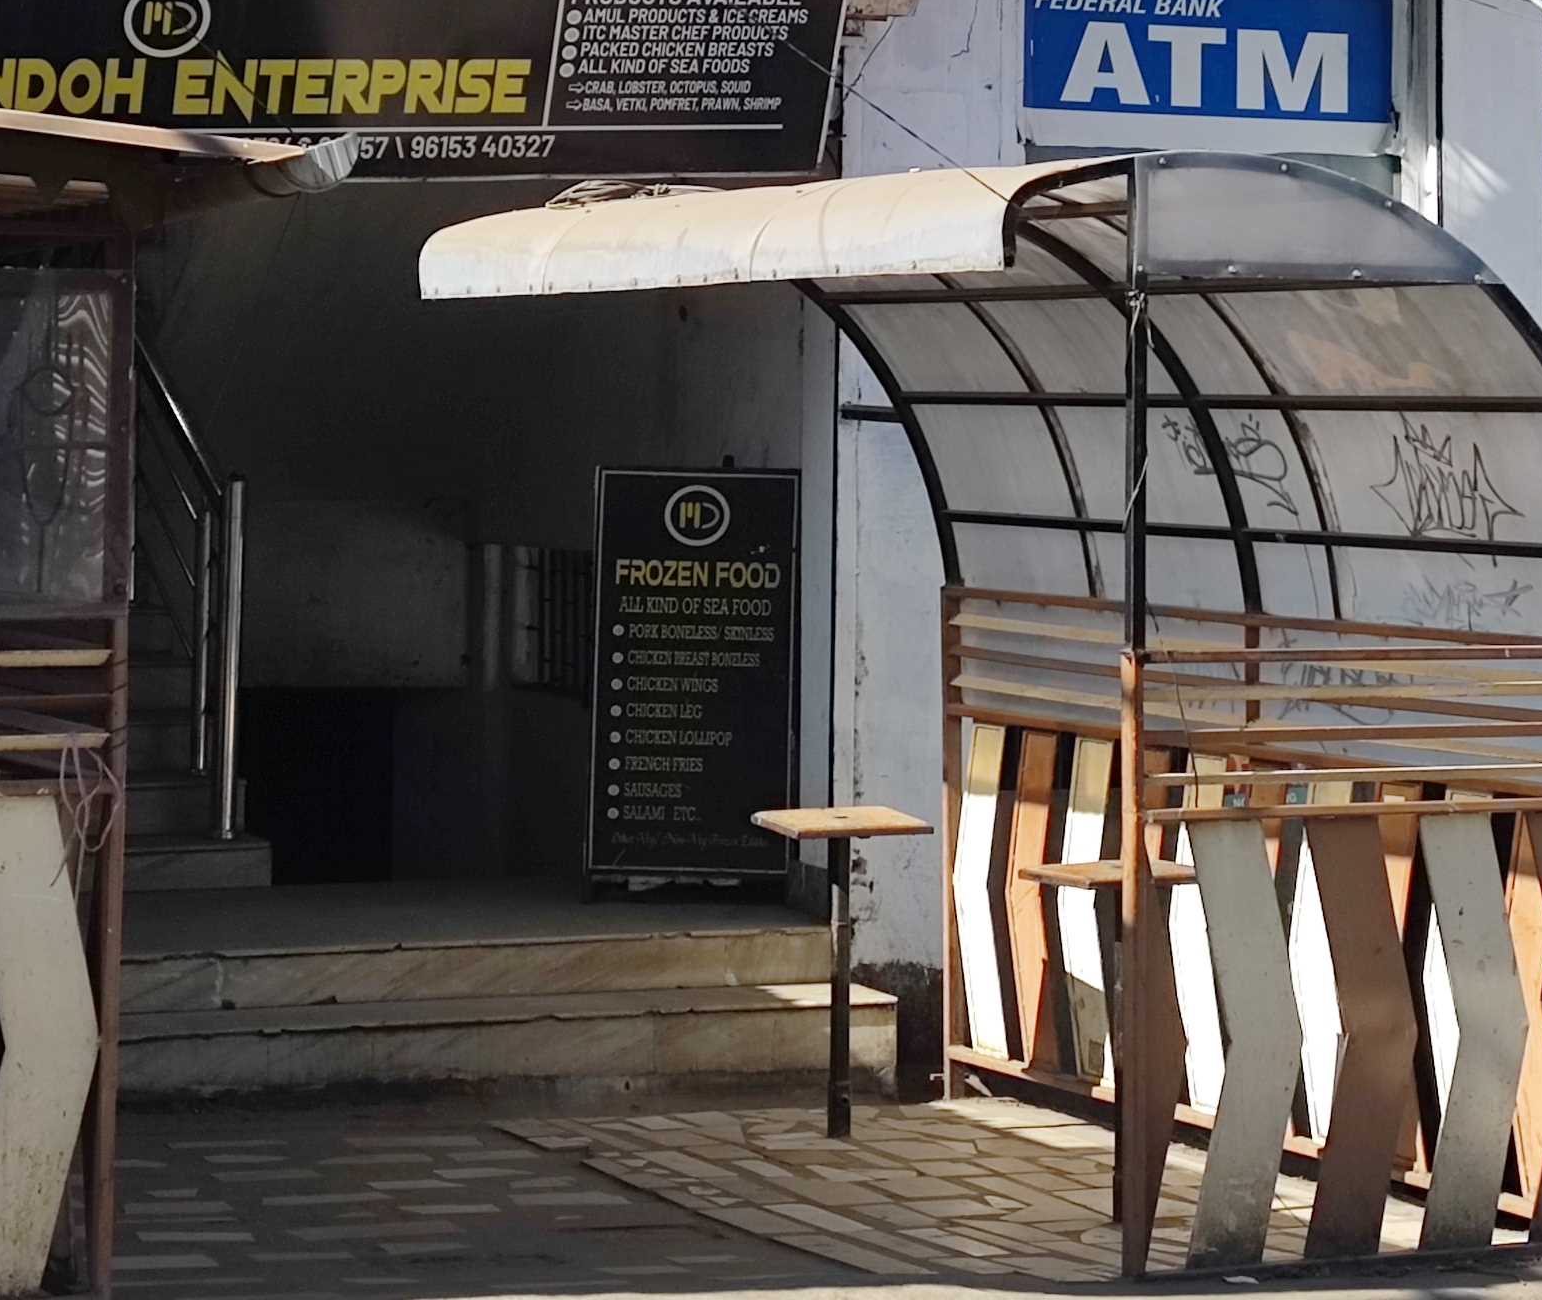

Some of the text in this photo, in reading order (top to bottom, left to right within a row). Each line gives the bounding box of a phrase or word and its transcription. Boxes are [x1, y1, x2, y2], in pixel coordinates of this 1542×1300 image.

[583, 8, 808, 24] AMUL PRODUCTS ICE CREAMS
[582, 25, 789, 41] ITC MASTER CHEF PRODUCTS
[579, 42, 775, 58] PACKED CHICKEN BREASTS
[577, 58, 750, 74] ALL KIND OF SEA FOODS
[1060, 20, 1349, 114] ATM
[173, 50, 532, 124] ENTERPRISE
[720, 80, 751, 95] SQUID
[411, 136, 477, 159] 96153
[481, 134, 556, 159] 40327
[615, 558, 781, 589] FROZEN FOOD
[619, 595, 772, 617] ALL KIND OF SEA FOOD
[680, 676, 719, 694] WINGS
[679, 703, 703, 720] LEG
[625, 755, 704, 773] FRENCH FRIES
